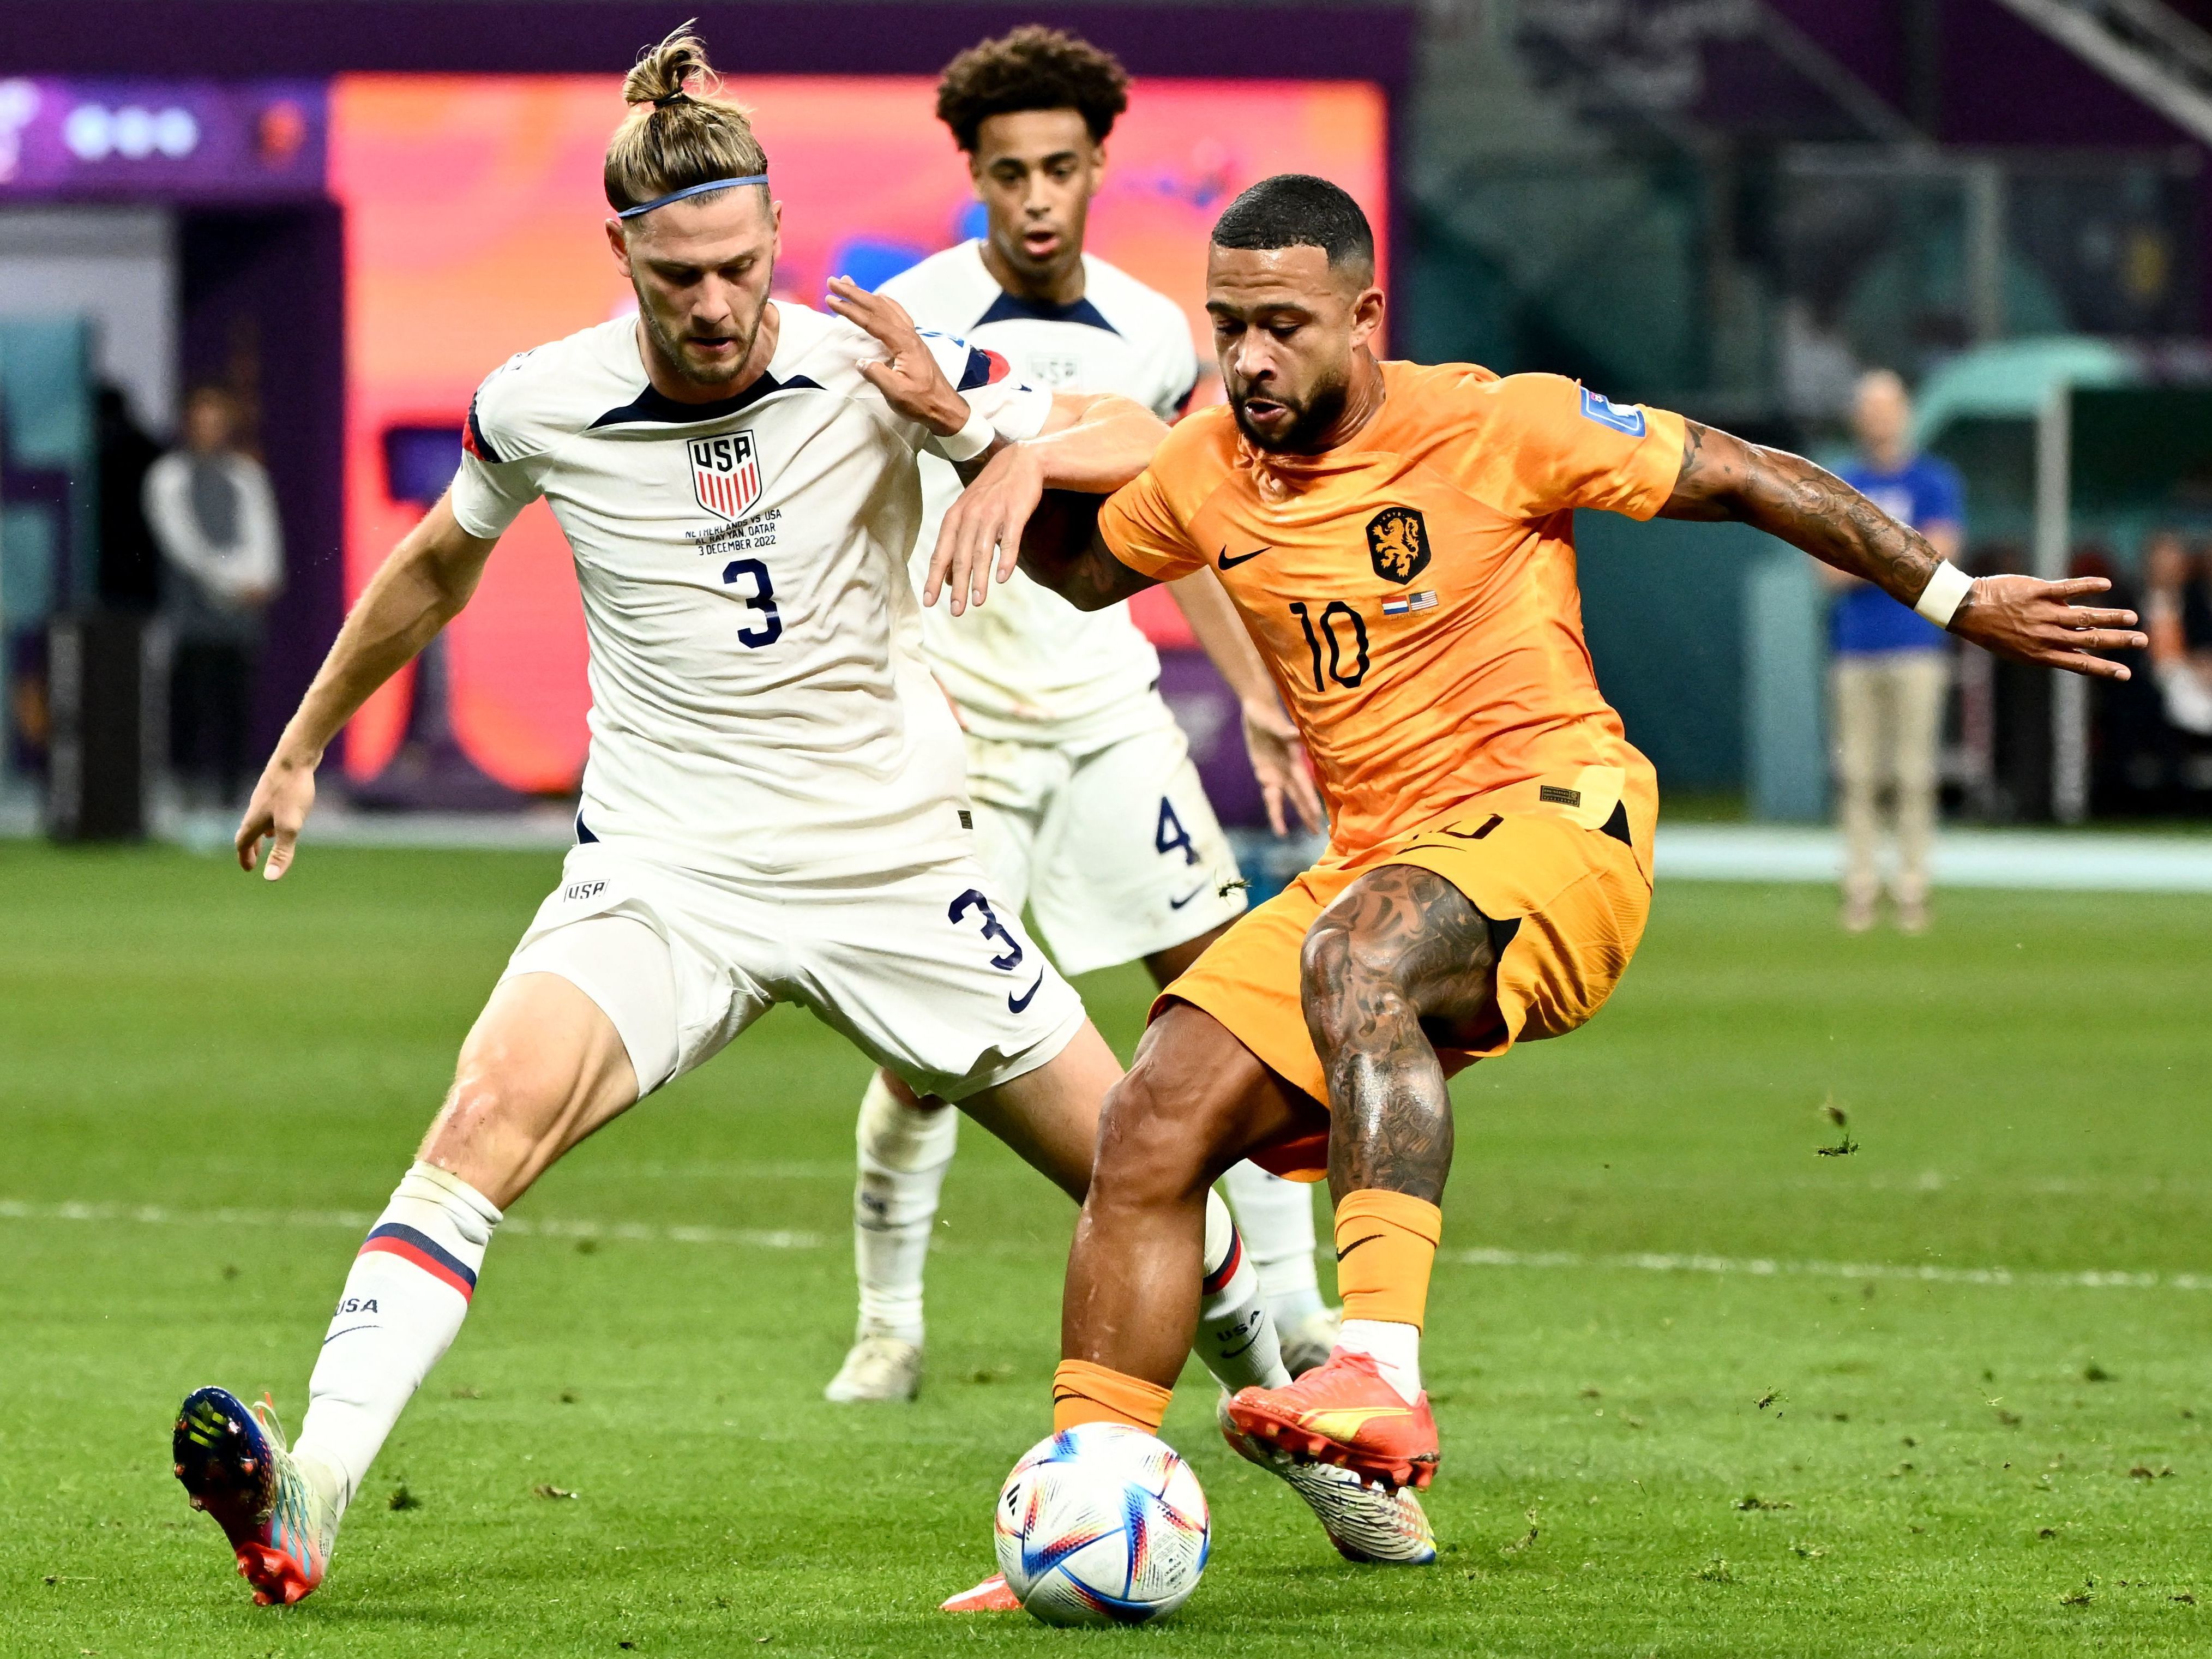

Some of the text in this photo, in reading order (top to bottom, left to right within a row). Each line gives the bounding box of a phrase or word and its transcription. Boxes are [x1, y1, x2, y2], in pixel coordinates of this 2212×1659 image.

[693, 436, 751, 472] USA
[685, 508, 782, 538] NETHERLANDS VS USA
[748, 522, 776, 536] QATAR
[698, 534, 776, 556] 3 DECEMBER 2022
[723, 558, 783, 649] 3
[1289, 601, 1370, 692] 10
[1155, 796, 1194, 865] 4
[568, 882, 605, 899] USA
[948, 888, 1023, 971] 3
[333, 1299, 378, 1317] USA
[1217, 1310, 1261, 1342] USA
